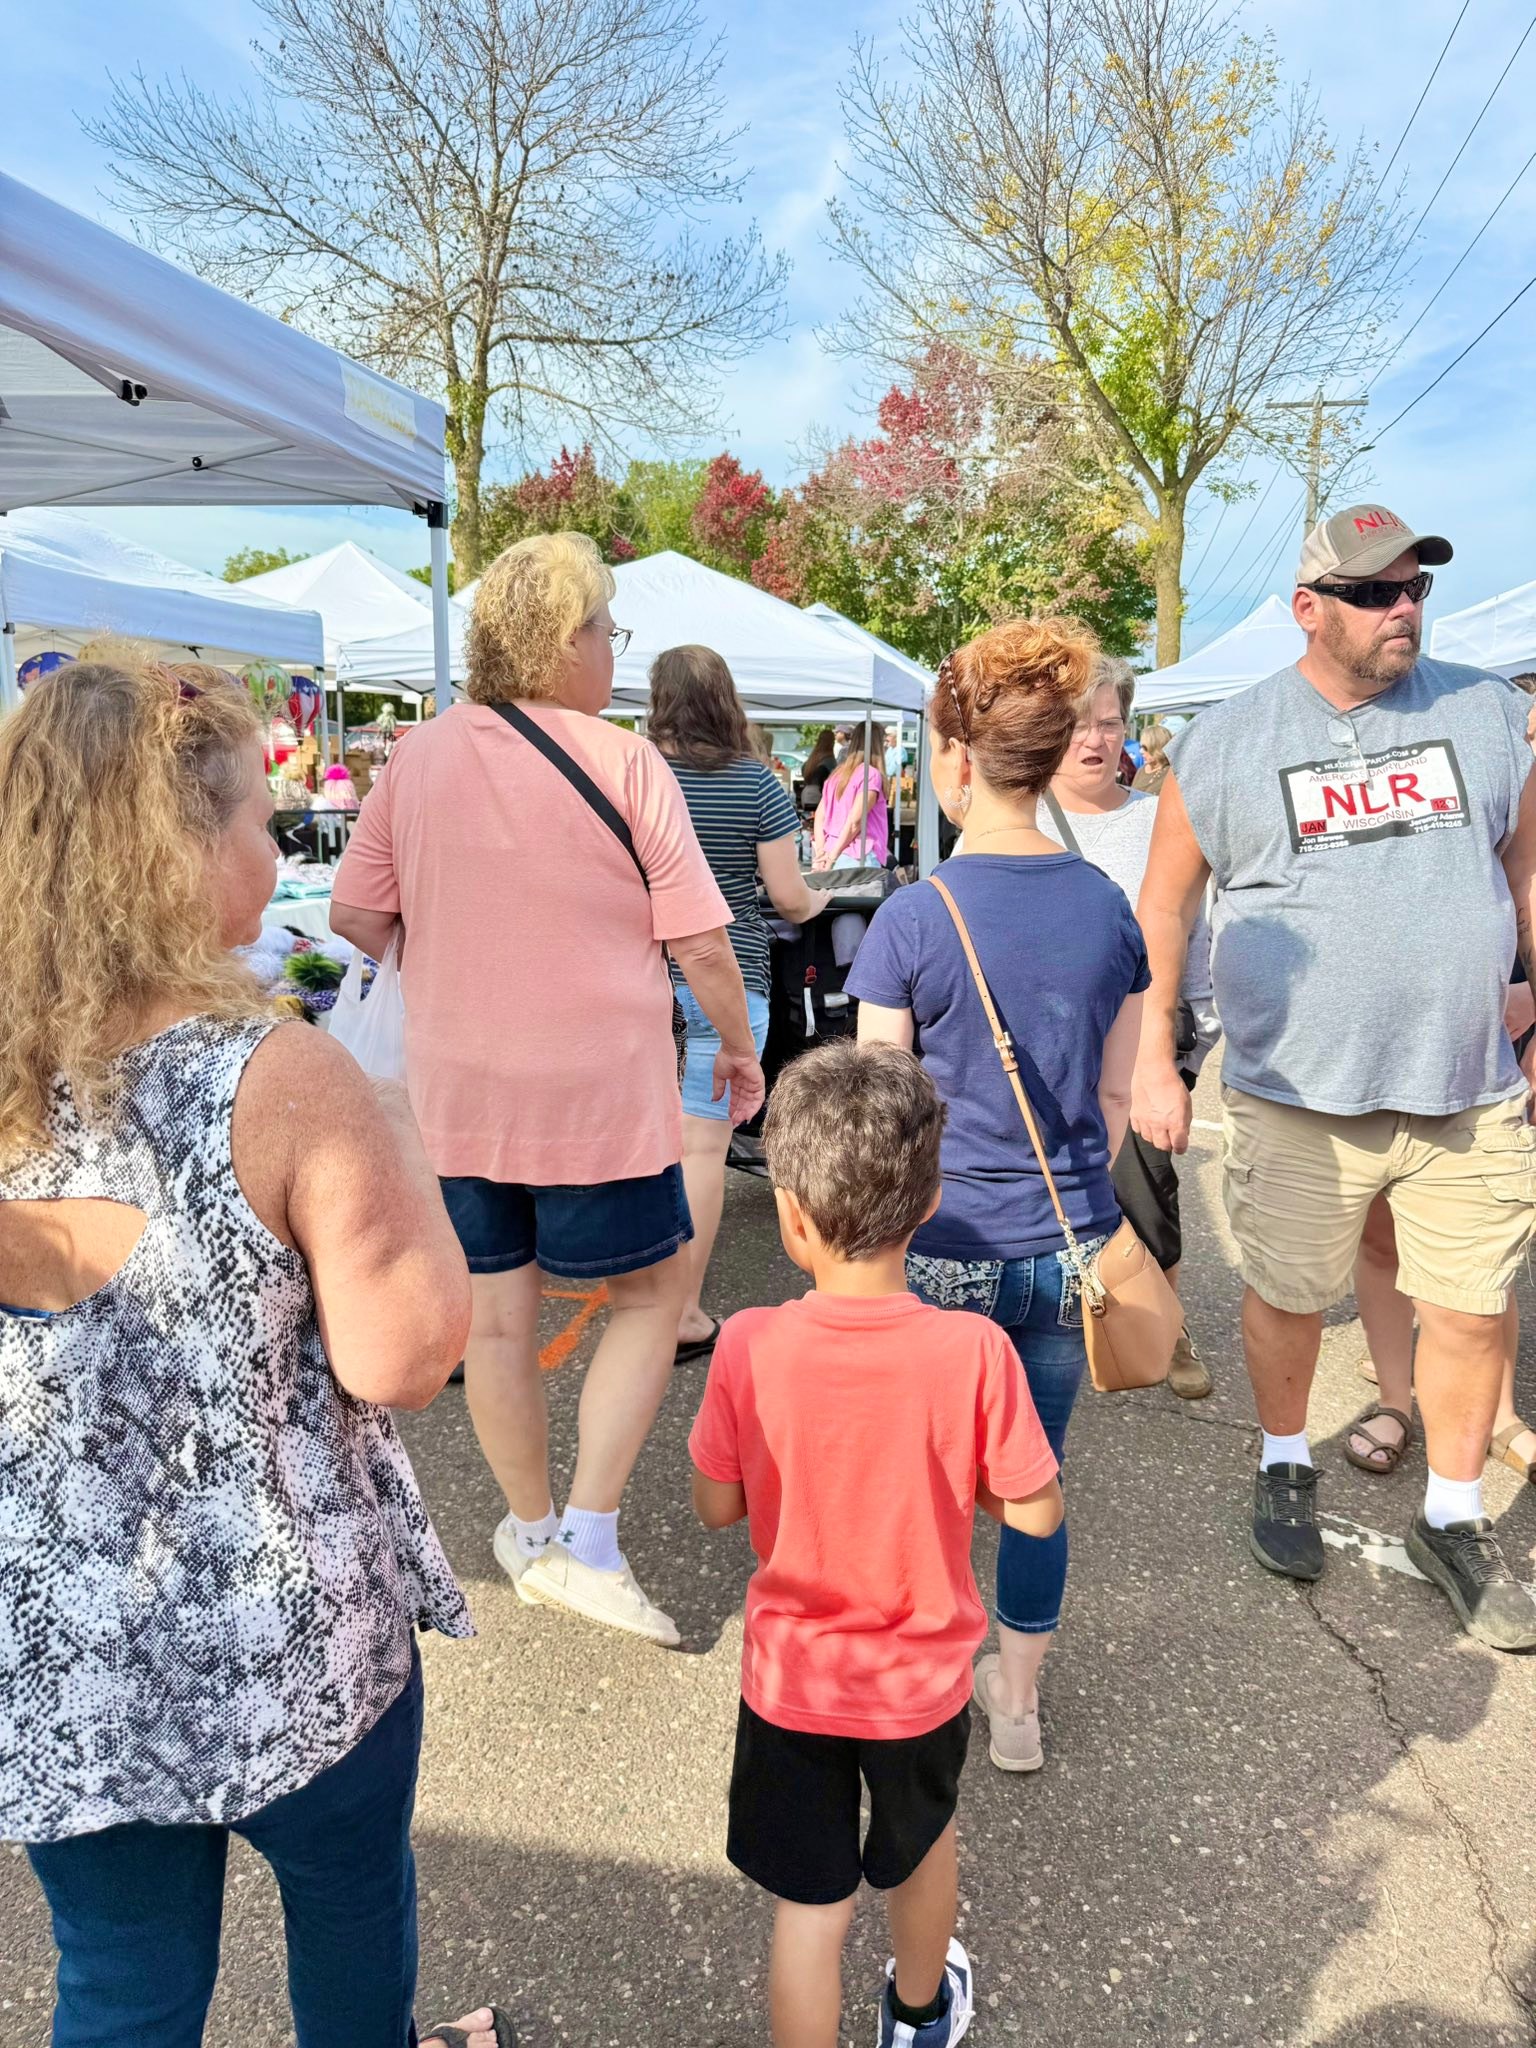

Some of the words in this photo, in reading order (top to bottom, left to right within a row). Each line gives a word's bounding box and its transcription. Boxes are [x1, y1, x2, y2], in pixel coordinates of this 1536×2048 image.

[1367, 756, 1428, 778] DAIRYLAND
[1322, 773, 1427, 818] NLR
[1301, 820, 1327, 834] JAN
[1343, 808, 1415, 830] WISCONSIN
[1301, 836, 1316, 846] Jon
